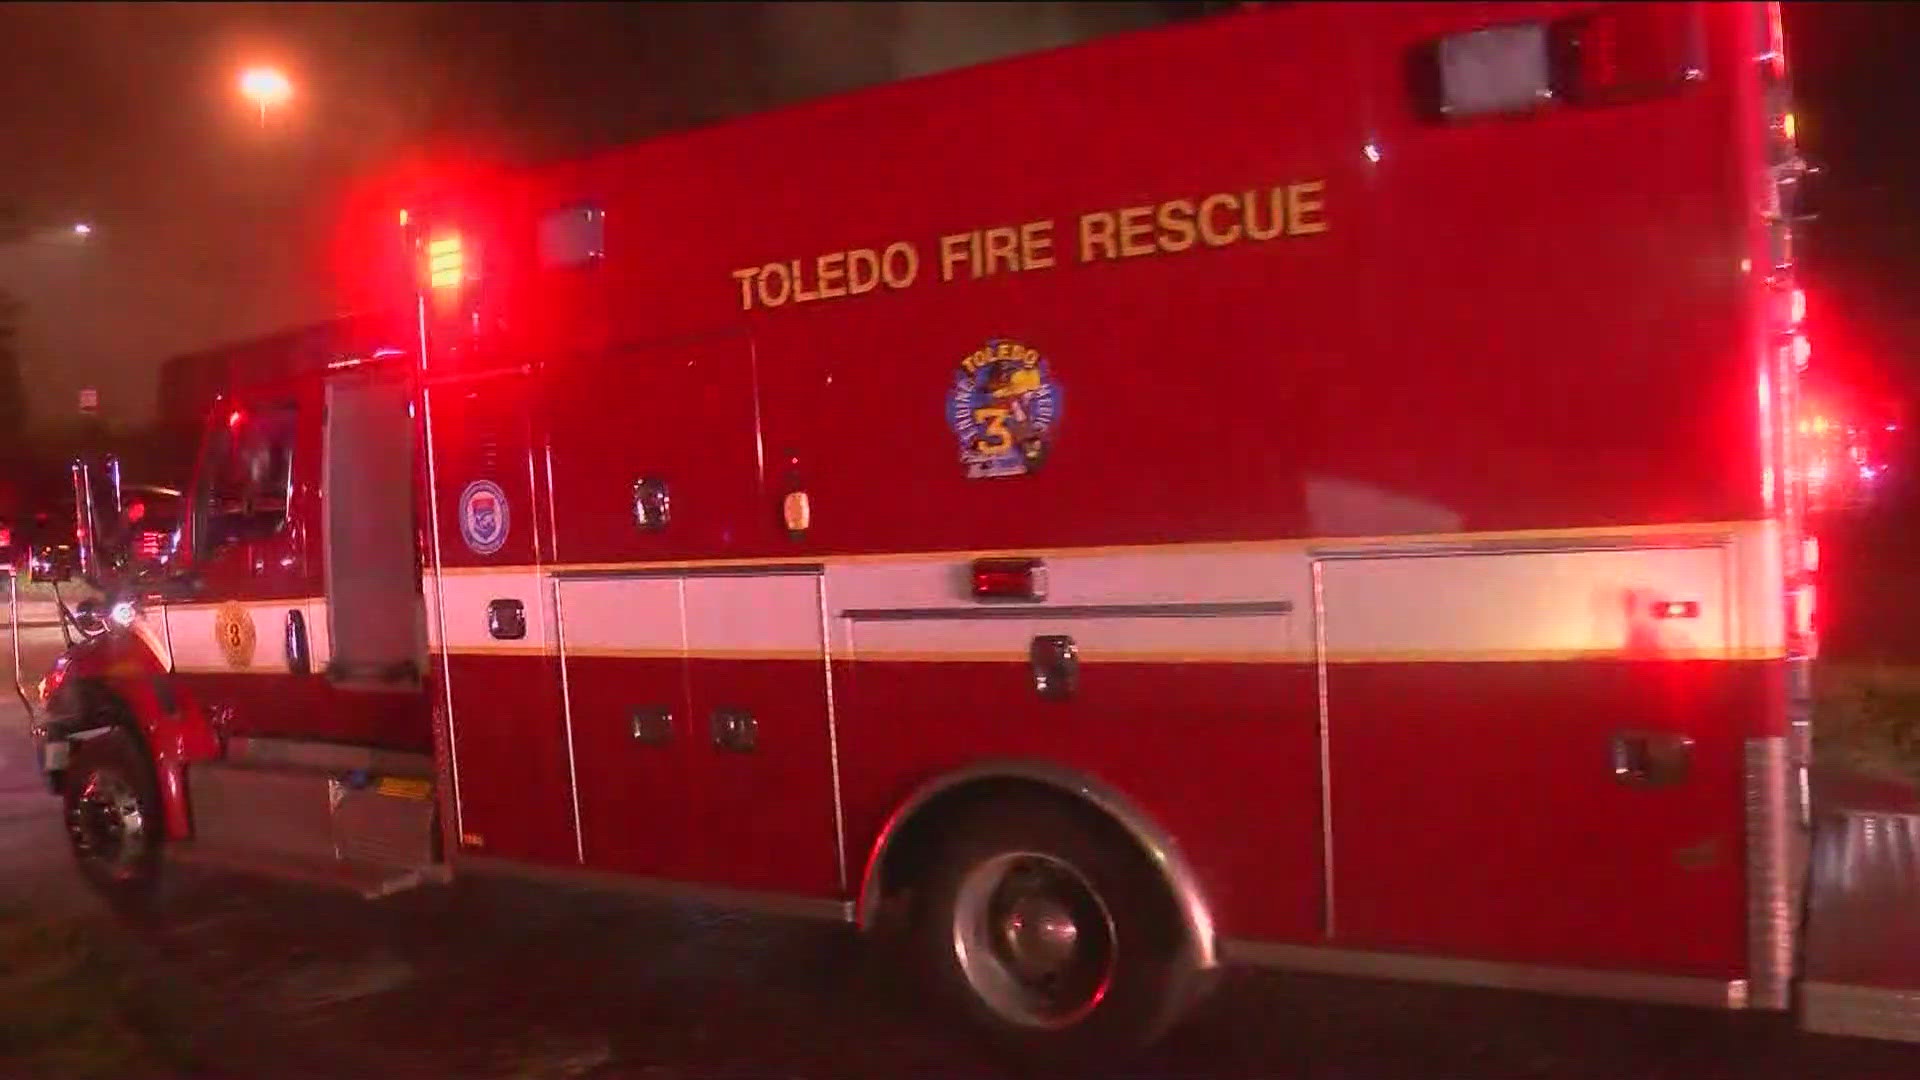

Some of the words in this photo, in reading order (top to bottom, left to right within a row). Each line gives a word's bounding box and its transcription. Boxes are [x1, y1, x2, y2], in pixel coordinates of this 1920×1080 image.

[733, 241, 920, 311] TOLEDO
[940, 219, 1056, 282] FIRE
[1079, 179, 1328, 263] RESCUE
[973, 407, 1013, 456] 3
[229, 623, 241, 647] 3
